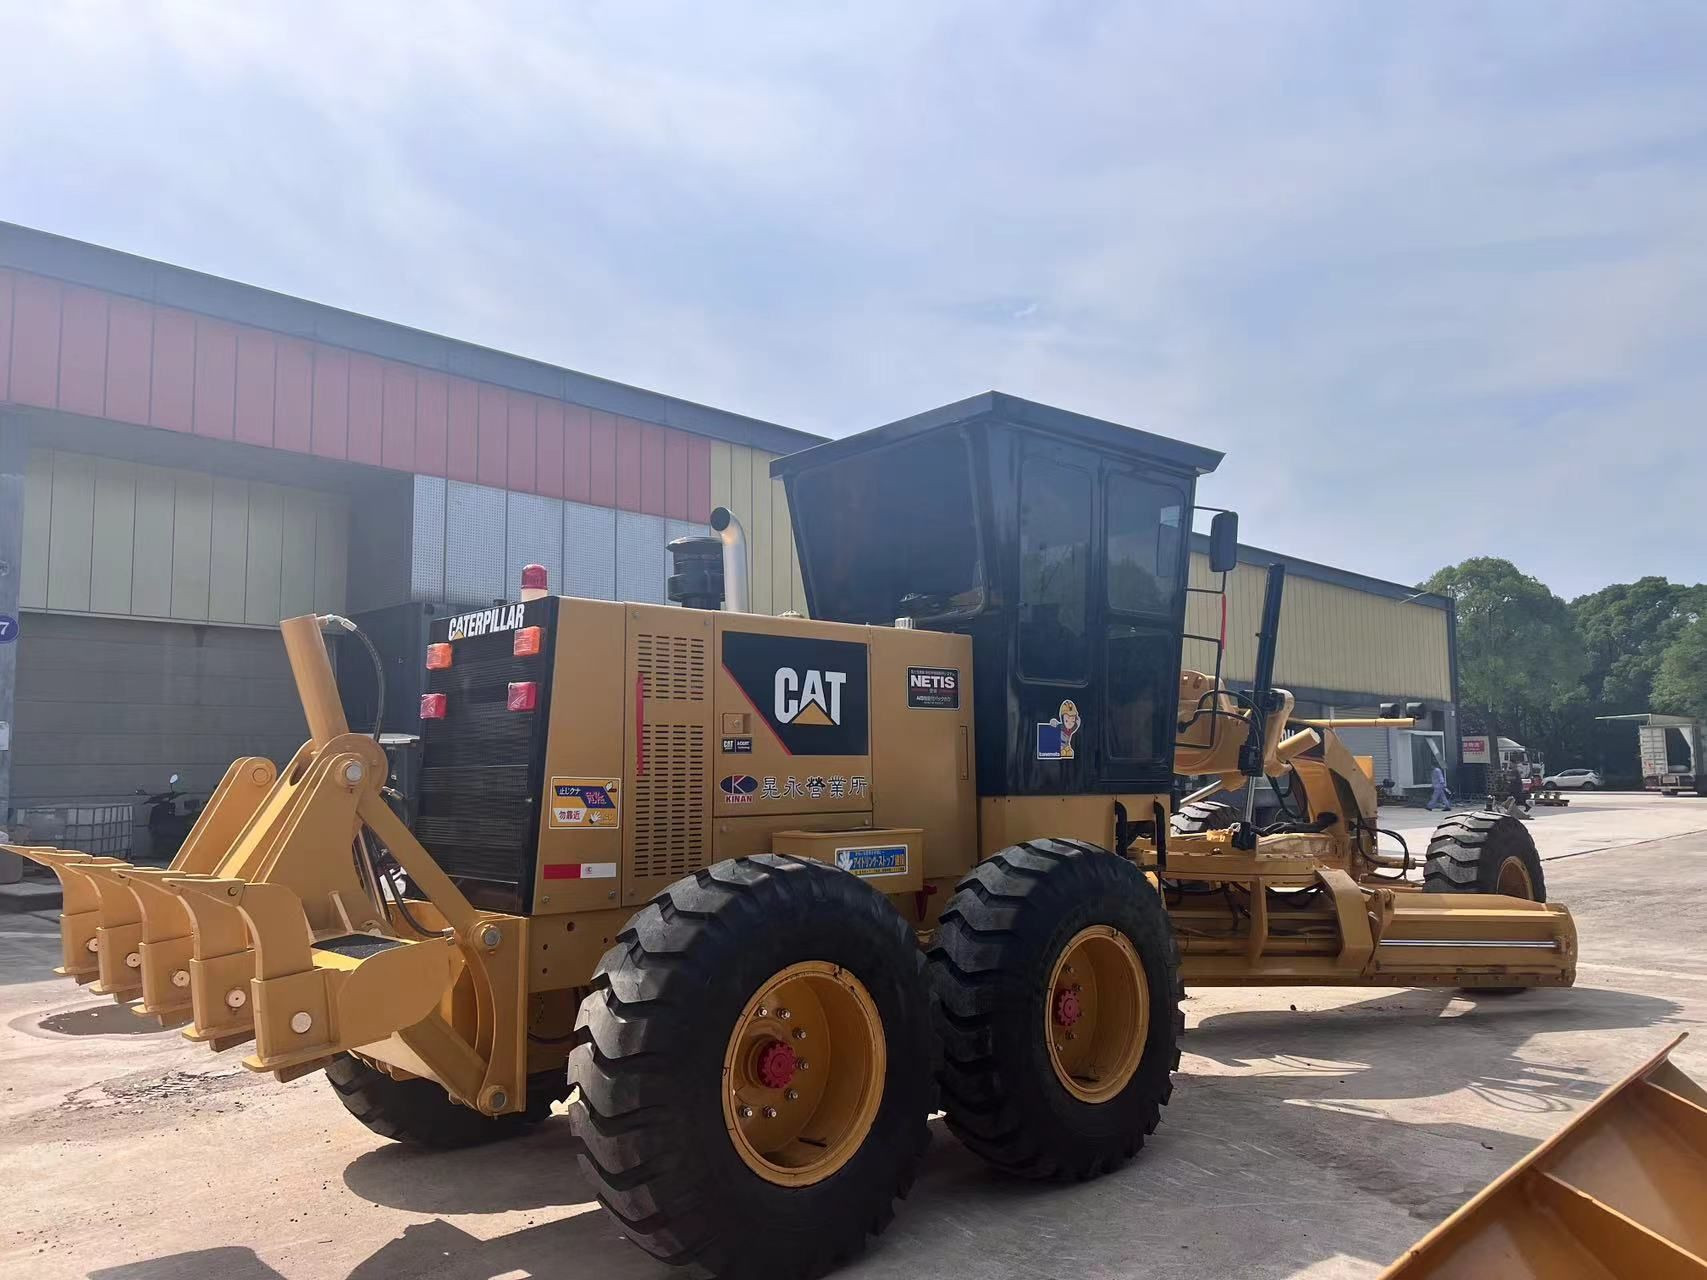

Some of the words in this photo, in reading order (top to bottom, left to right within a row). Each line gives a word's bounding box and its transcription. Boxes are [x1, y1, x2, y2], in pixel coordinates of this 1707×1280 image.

[448, 604, 525, 641] CATERPILLAR
[910, 674, 955, 689] NETIS
[774, 667, 847, 726] CAT
[725, 794, 752, 803] KINAN
